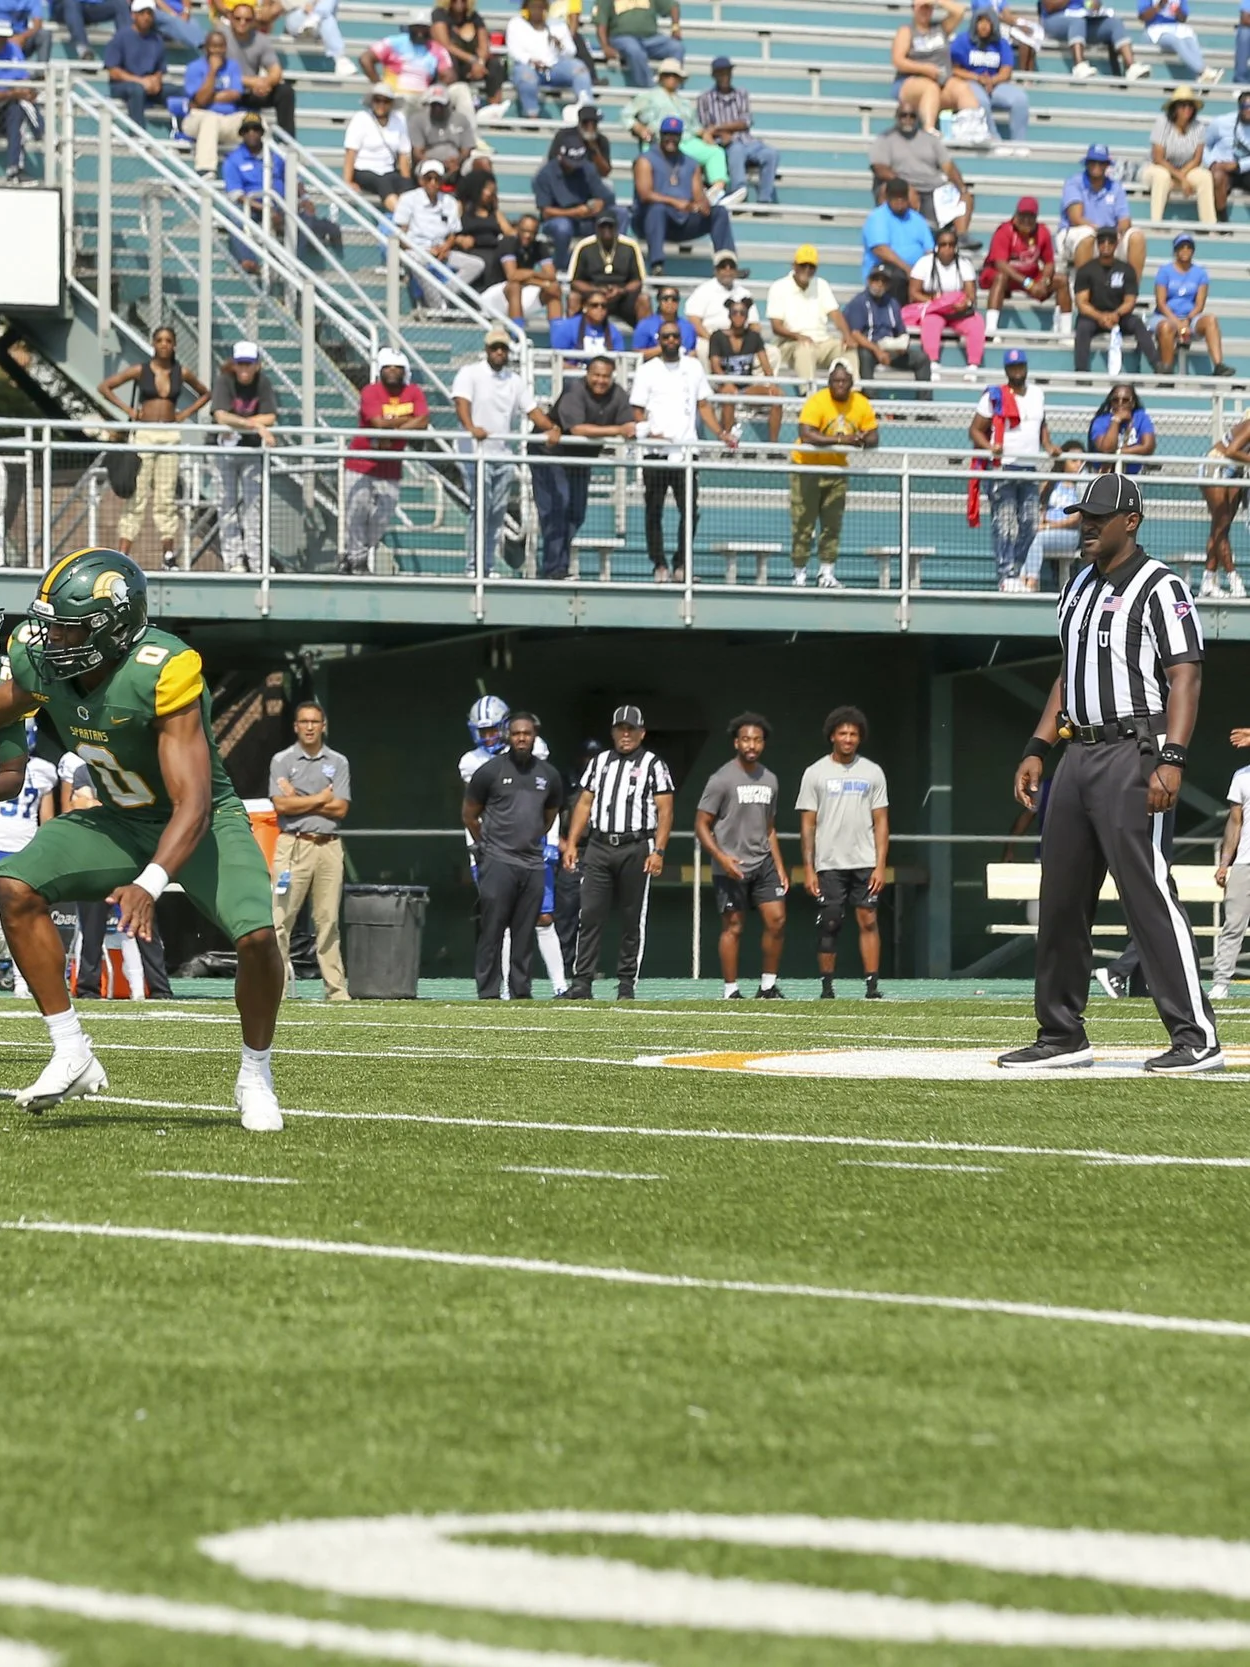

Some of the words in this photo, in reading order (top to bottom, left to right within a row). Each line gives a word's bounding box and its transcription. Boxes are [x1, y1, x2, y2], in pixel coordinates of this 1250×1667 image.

[1128, 498, 1135, 506] S
[1098, 630, 1111, 649] U
[135, 645, 170, 666] 0
[69, 726, 109, 743] SPARTANS
[75, 743, 157, 809] 0
